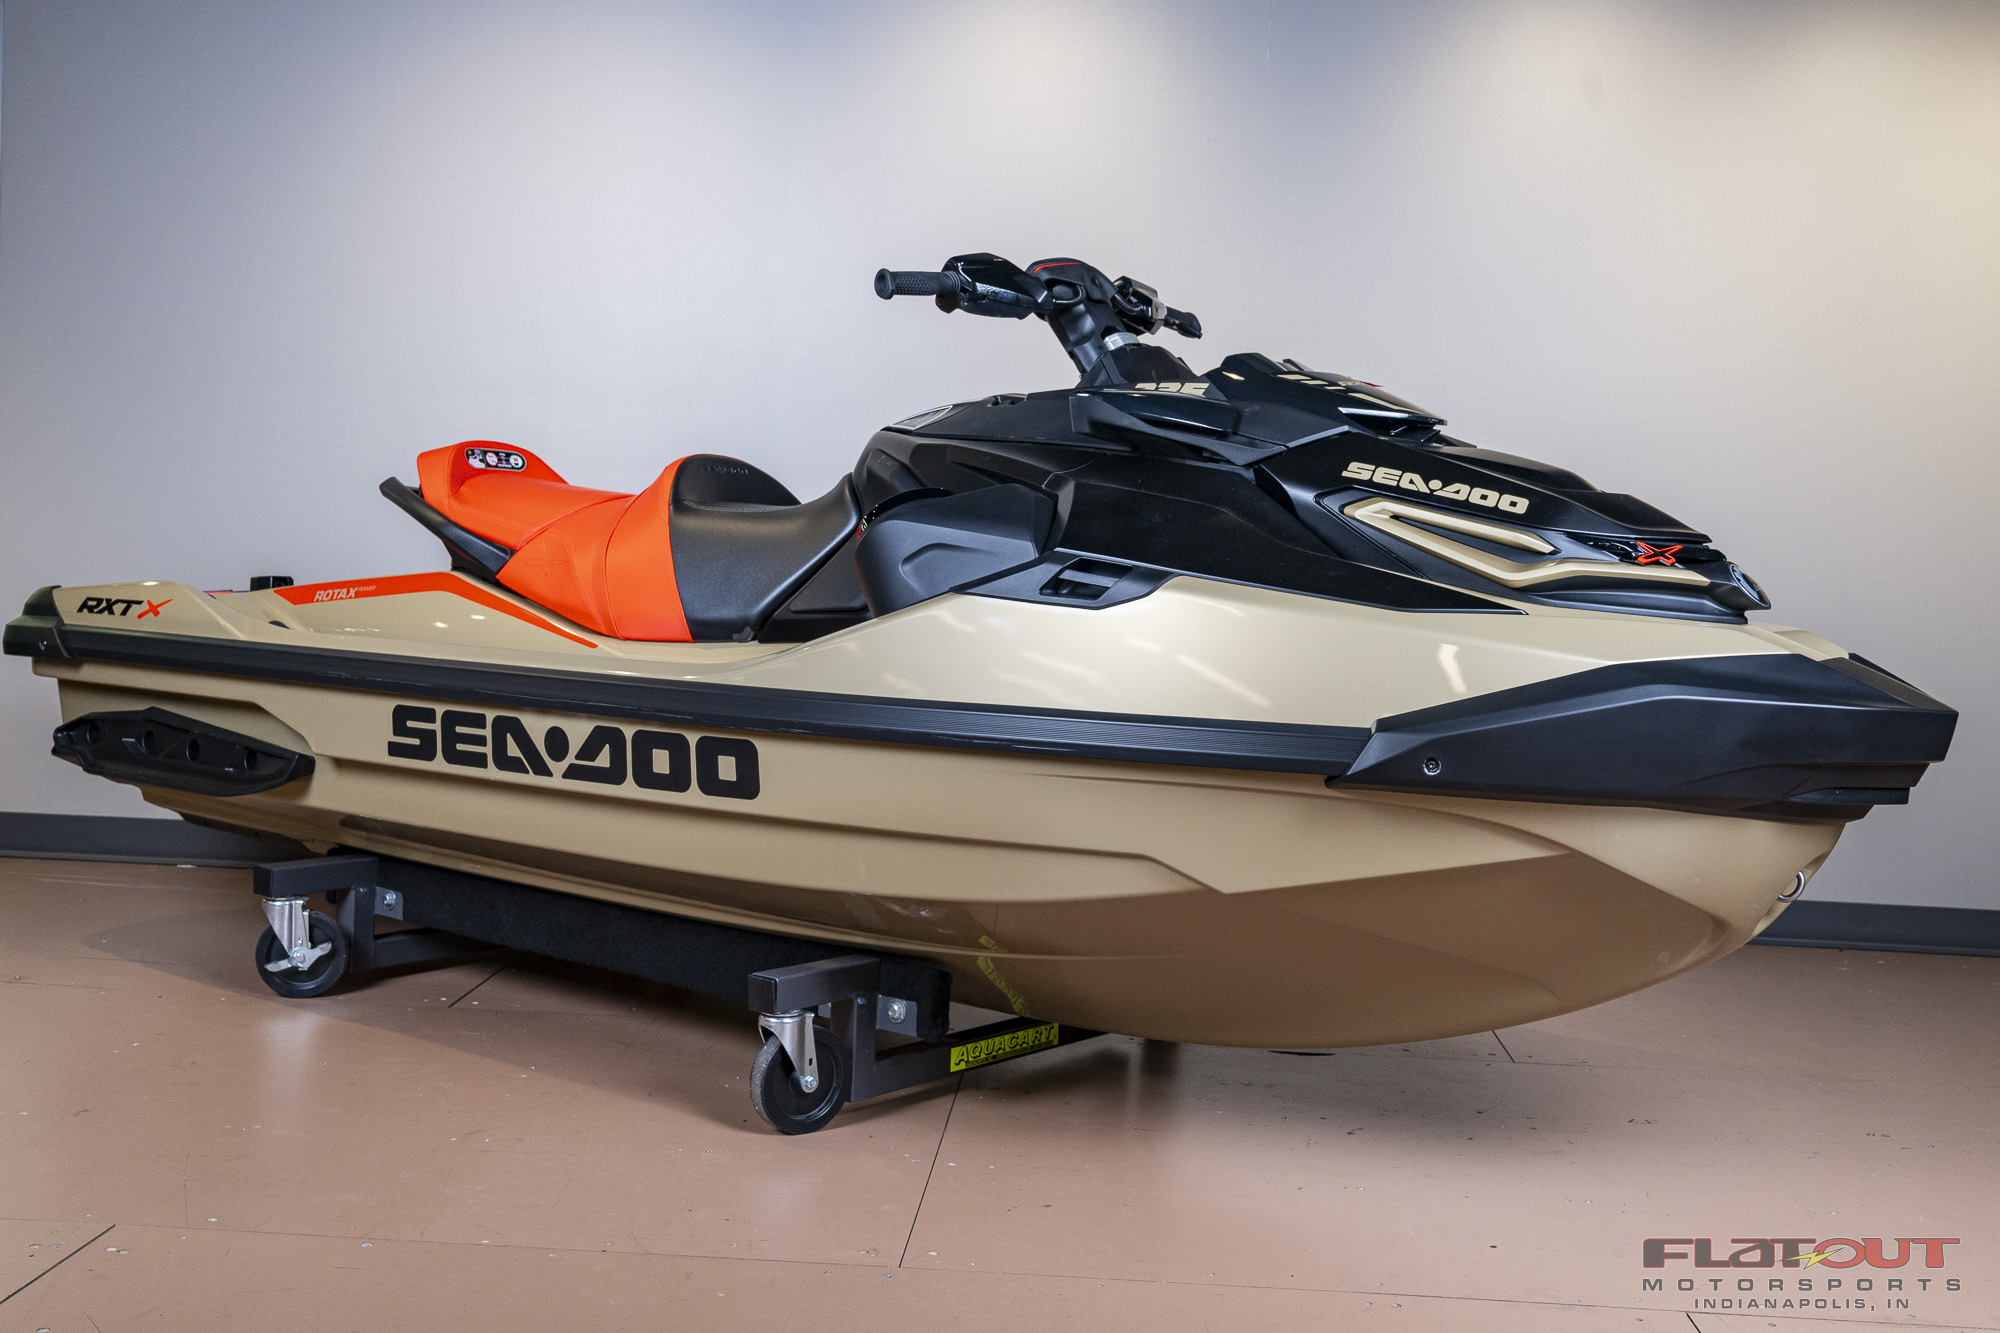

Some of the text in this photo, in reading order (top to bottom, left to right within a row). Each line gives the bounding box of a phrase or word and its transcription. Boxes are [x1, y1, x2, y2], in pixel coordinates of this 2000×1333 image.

[313, 586, 358, 602] ROTAX
[76, 596, 145, 617] RXT
[954, 1024, 1055, 1067] AQUACART
